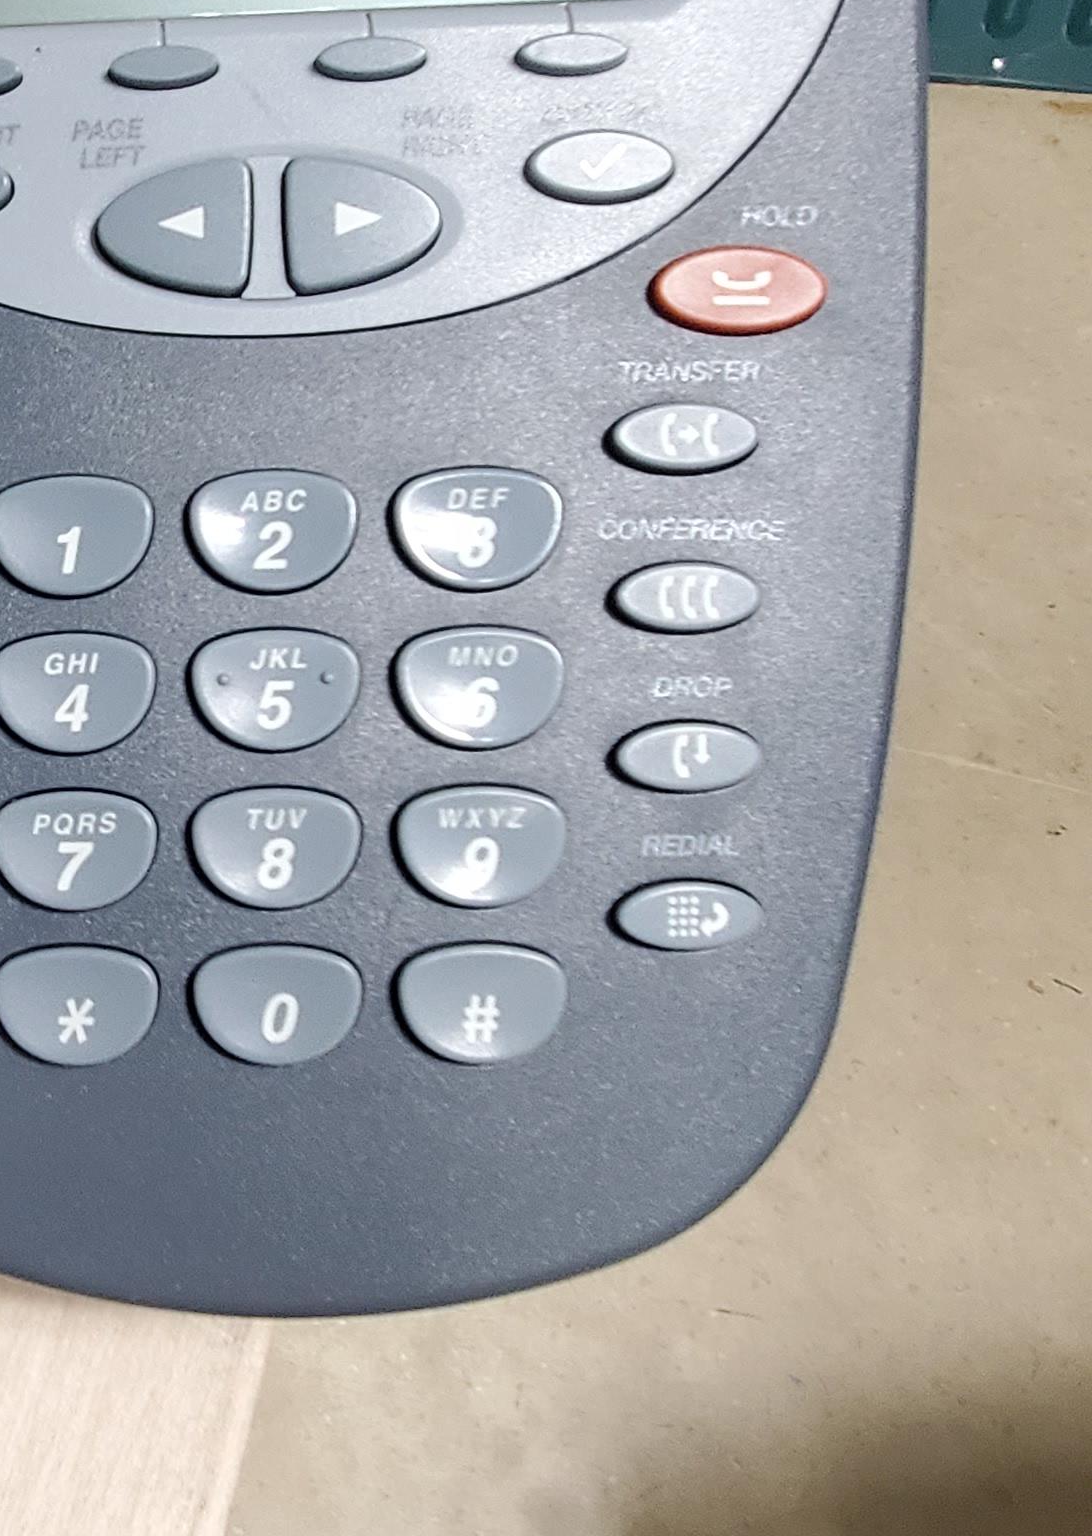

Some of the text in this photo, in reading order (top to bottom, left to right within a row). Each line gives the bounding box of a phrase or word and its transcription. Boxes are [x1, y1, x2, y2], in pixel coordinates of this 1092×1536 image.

[71, 117, 144, 142] PAGE
[79, 145, 146, 169] LEFT
[740, 205, 818, 227] HOLD
[619, 362, 761, 383] TRANSFER
[240, 489, 307, 513] ABC
[447, 487, 510, 510] DEF
[597, 519, 786, 542] CONFERENCE
[56, 526, 83, 575] 1
[254, 521, 295, 570] 2
[43, 652, 99, 675] GHI
[249, 647, 307, 670] JKL
[448, 644, 519, 667] MNO
[651, 676, 734, 698] DROP
[54, 684, 90, 732] 4
[258, 681, 294, 730] 5
[461, 676, 500, 728] 6
[32, 812, 117, 835] PQRS
[247, 807, 307, 830] TUV
[437, 806, 527, 828] WXYZ
[641, 834, 739, 856] REDIAL
[55, 841, 94, 891] 7
[256, 838, 296, 888] 8
[461, 837, 500, 888] 9
[261, 993, 299, 1044] 0
